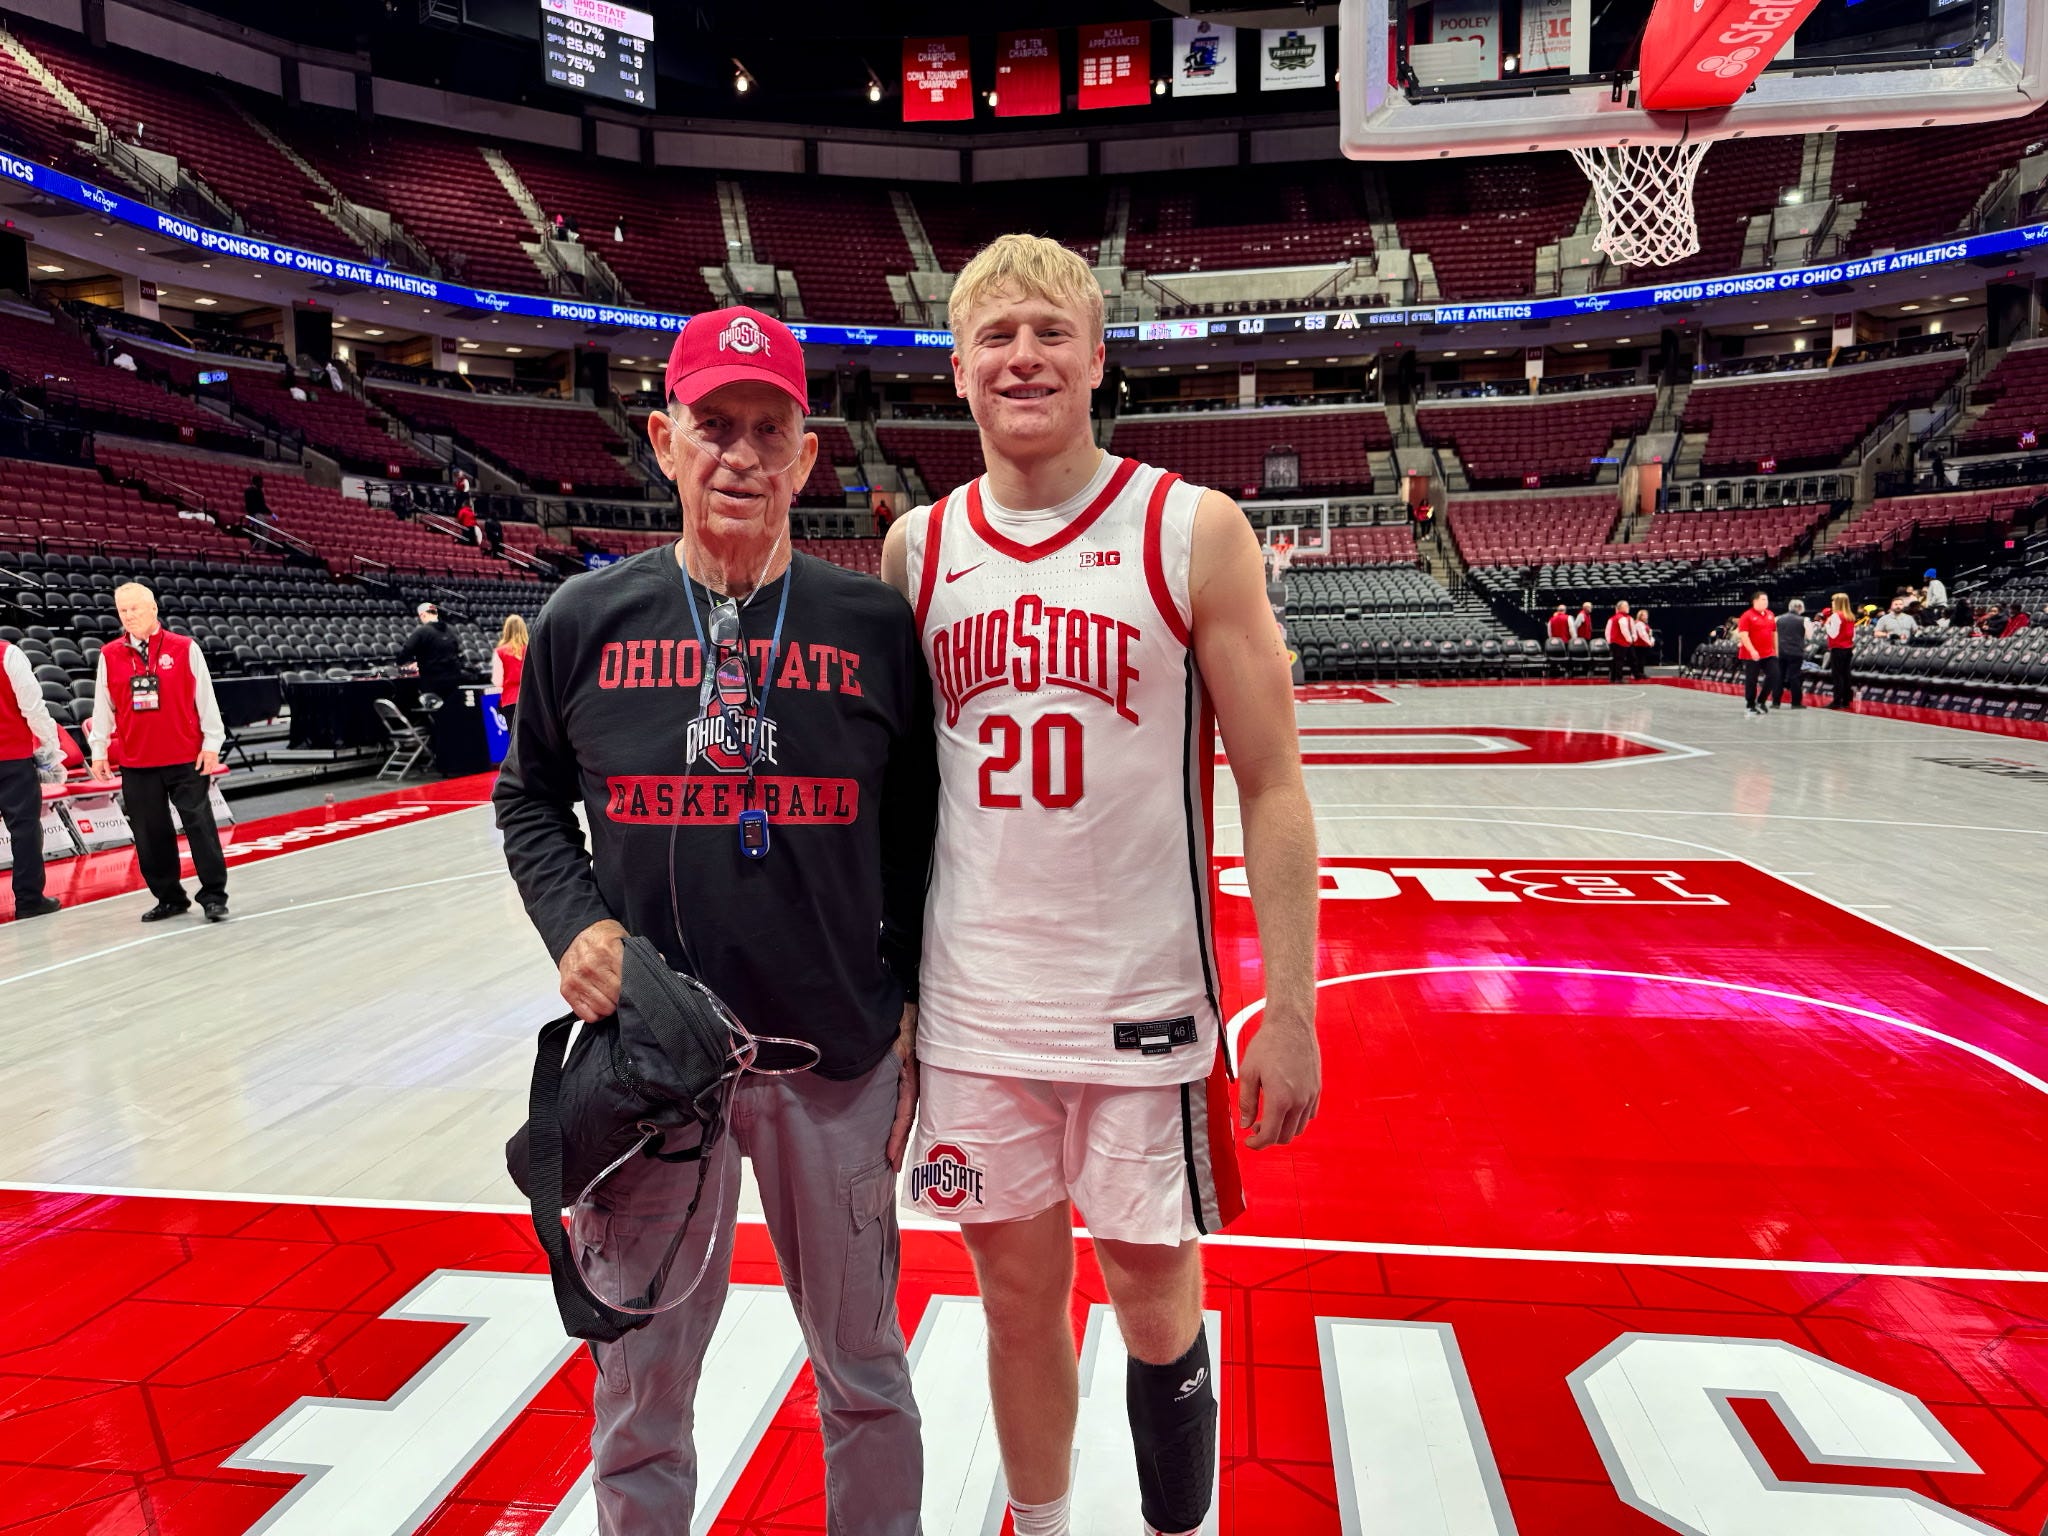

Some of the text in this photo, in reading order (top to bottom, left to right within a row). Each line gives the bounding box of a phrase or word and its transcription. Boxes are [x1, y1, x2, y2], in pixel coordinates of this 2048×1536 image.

[573, 0, 627, 20] OHIO STATE
[573, 7, 624, 29] TEAM STATS
[565, 20, 605, 41] 40.7%
[1440, 16, 1492, 30] POOLEY
[566, 36, 606, 58] 25.9%
[633, 39, 645, 53] 15
[1014, 39, 1042, 49] BIG TEN
[1088, 36, 1140, 48] APPEARANCES
[918, 52, 956, 62] CHAMPIONS
[1009, 48, 1048, 58] CHAMPIONS
[566, 54, 596, 73] 75%
[634, 55, 643, 69] 3
[567, 71, 585, 87] 39
[634, 72, 640, 85] 1
[926, 69, 969, 80] TOURNAMENT
[918, 80, 957, 89] CHAMPIONS
[635, 90, 645, 103] 4
[93, 190, 118, 212] Kroger
[158, 215, 437, 296] PROUD SPONSOR OF OHIO STATE ATHLETICS
[1654, 244, 1967, 303] PROUD SPONSOR OF OHIO STATE ATHLETICS
[485, 294, 510, 311] Kroger
[1585, 297, 1611, 311] Kroger
[552, 303, 597, 320] PROUD
[599, 309, 658, 328] SPONSOR
[660, 317, 676, 330] OF
[1467, 305, 1532, 321] ATHLETICS
[1179, 323, 1199, 337] 75
[1239, 318, 1265, 334] 0.0
[1305, 314, 1326, 330] 53
[915, 333, 955, 346] PROUD
[181, 427, 194, 437] 107
[598, 638, 865, 698] OHIO STATE
[933, 594, 1141, 730] OHIO STATE
[978, 713, 1085, 810] 20
[612, 783, 850, 818] BASKETBALL
[94, 819, 126, 830] TOYOTA
[1173, 1025, 1187, 1038] 46
[911, 1159, 984, 1205] OHIO STATE
